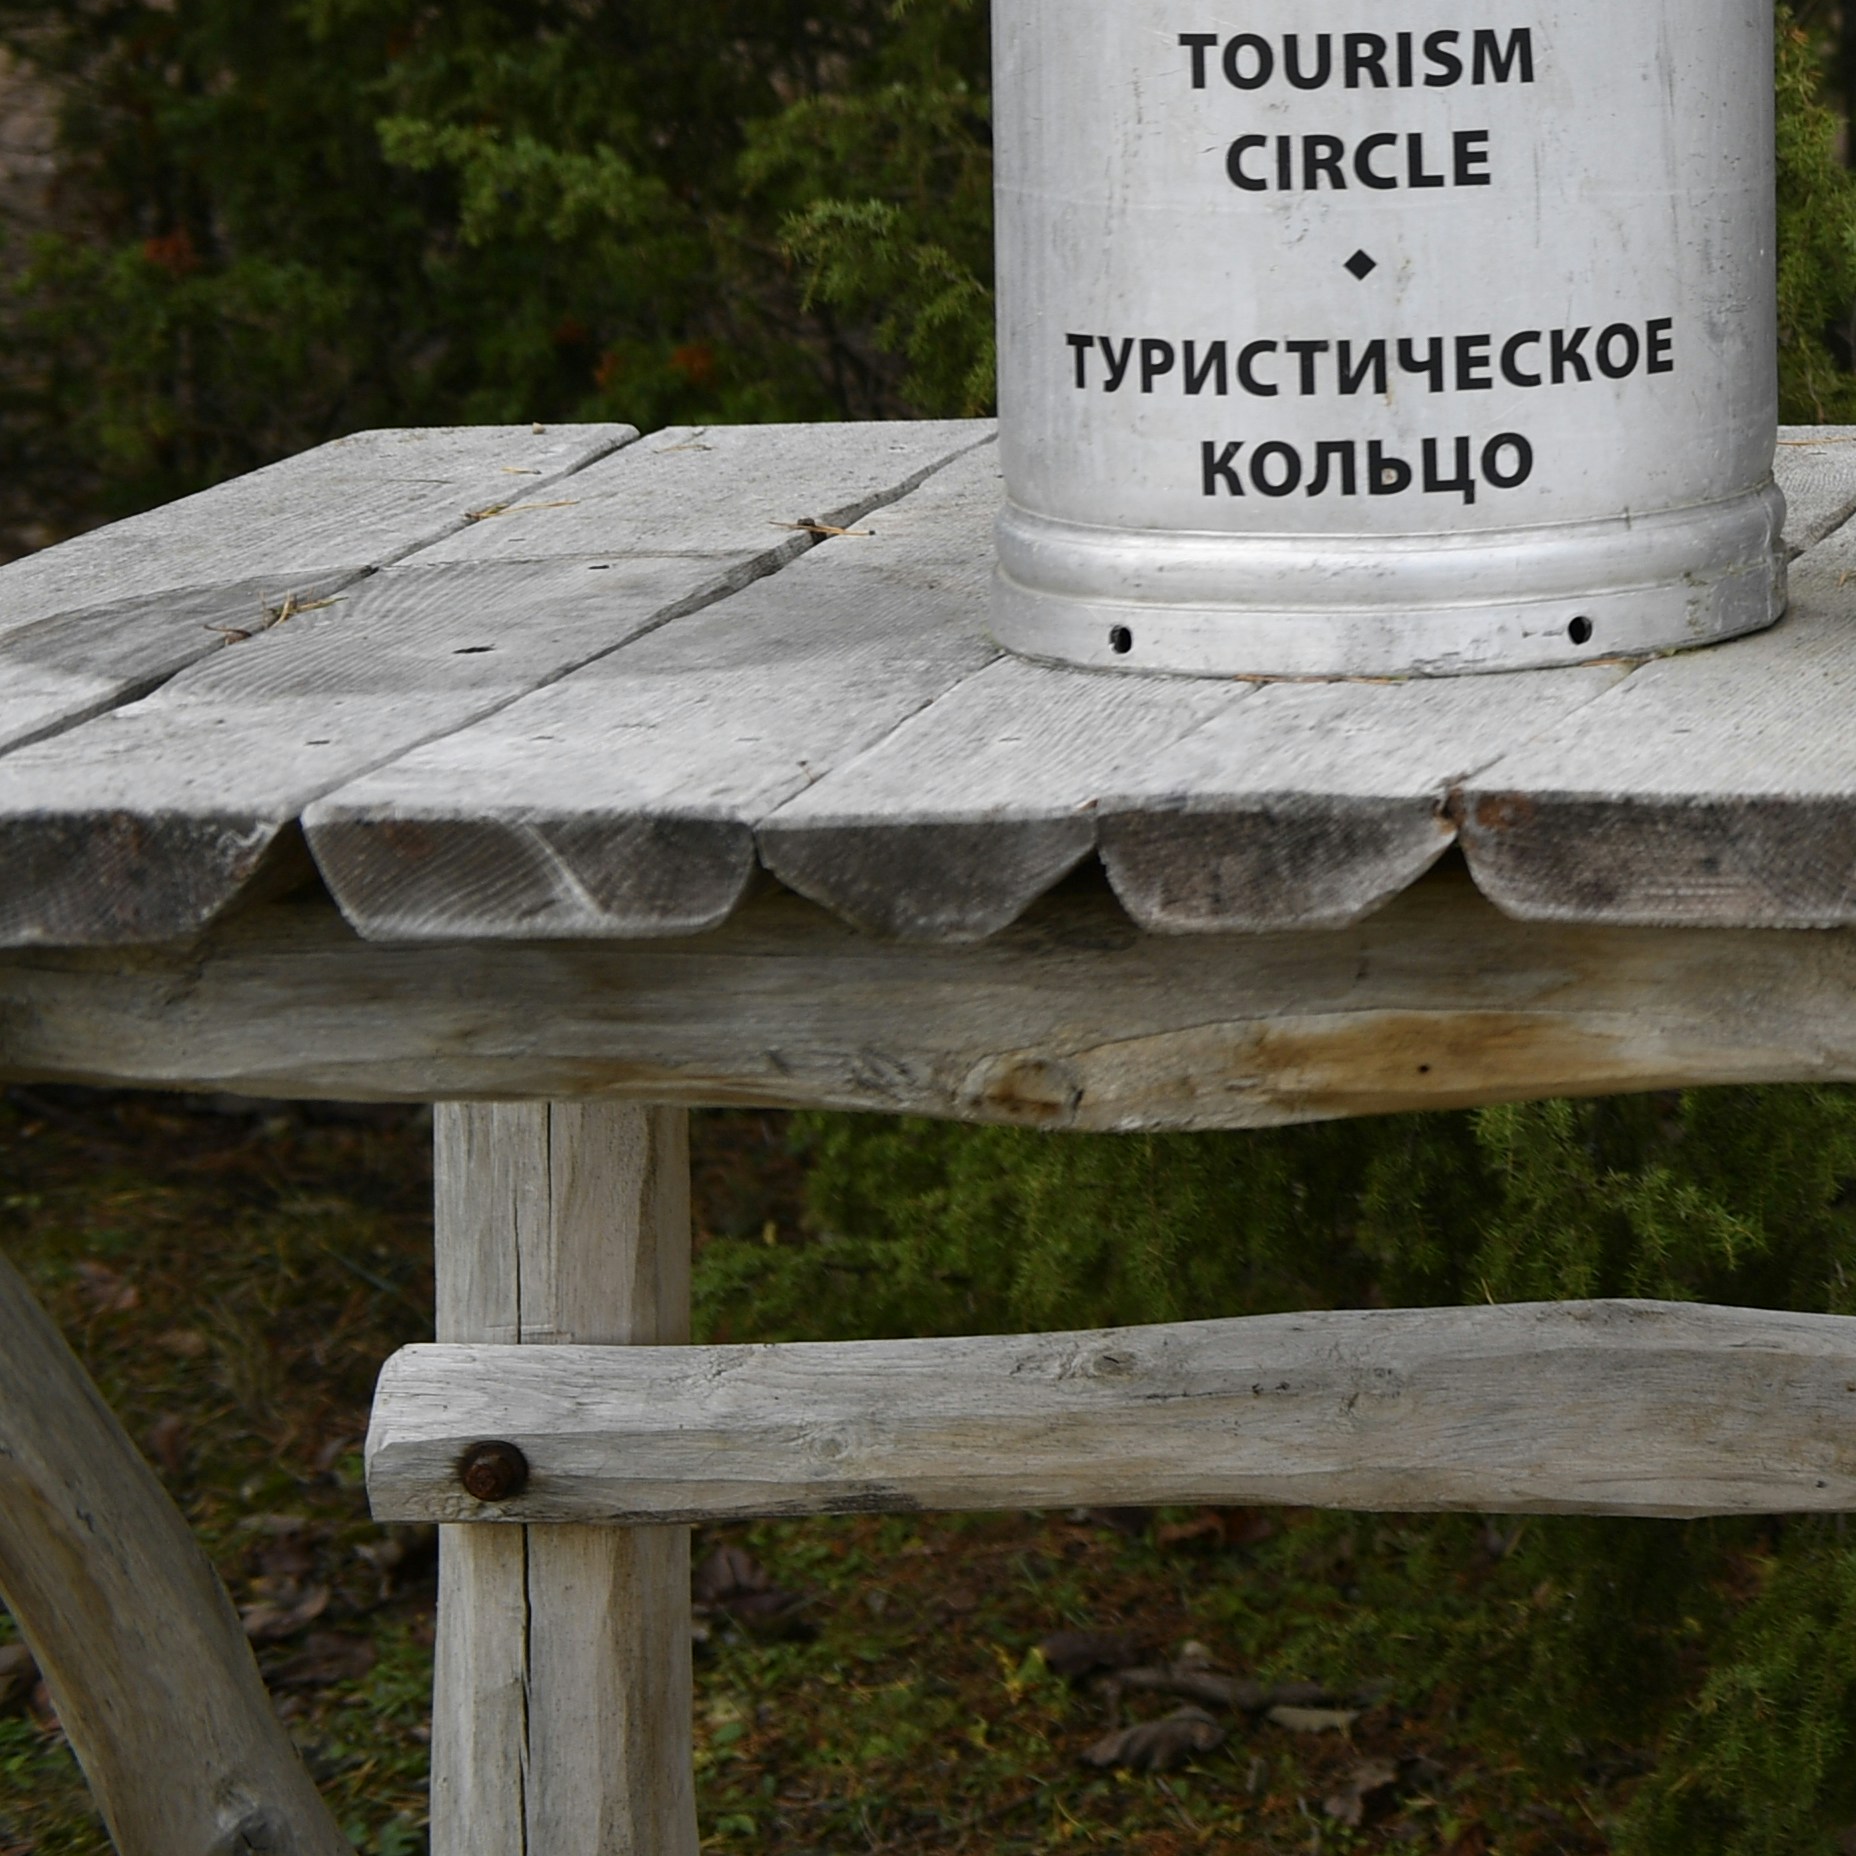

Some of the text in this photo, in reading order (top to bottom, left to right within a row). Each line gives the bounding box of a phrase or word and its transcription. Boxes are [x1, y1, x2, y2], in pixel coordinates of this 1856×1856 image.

[1179, 28, 1534, 90] TOURISM
[1227, 130, 1490, 191] CIRCLE
[1066, 317, 1673, 396] ТУРИСТИЧЕСКОЕ
[1203, 433, 1532, 504] КОЛЬЦО
